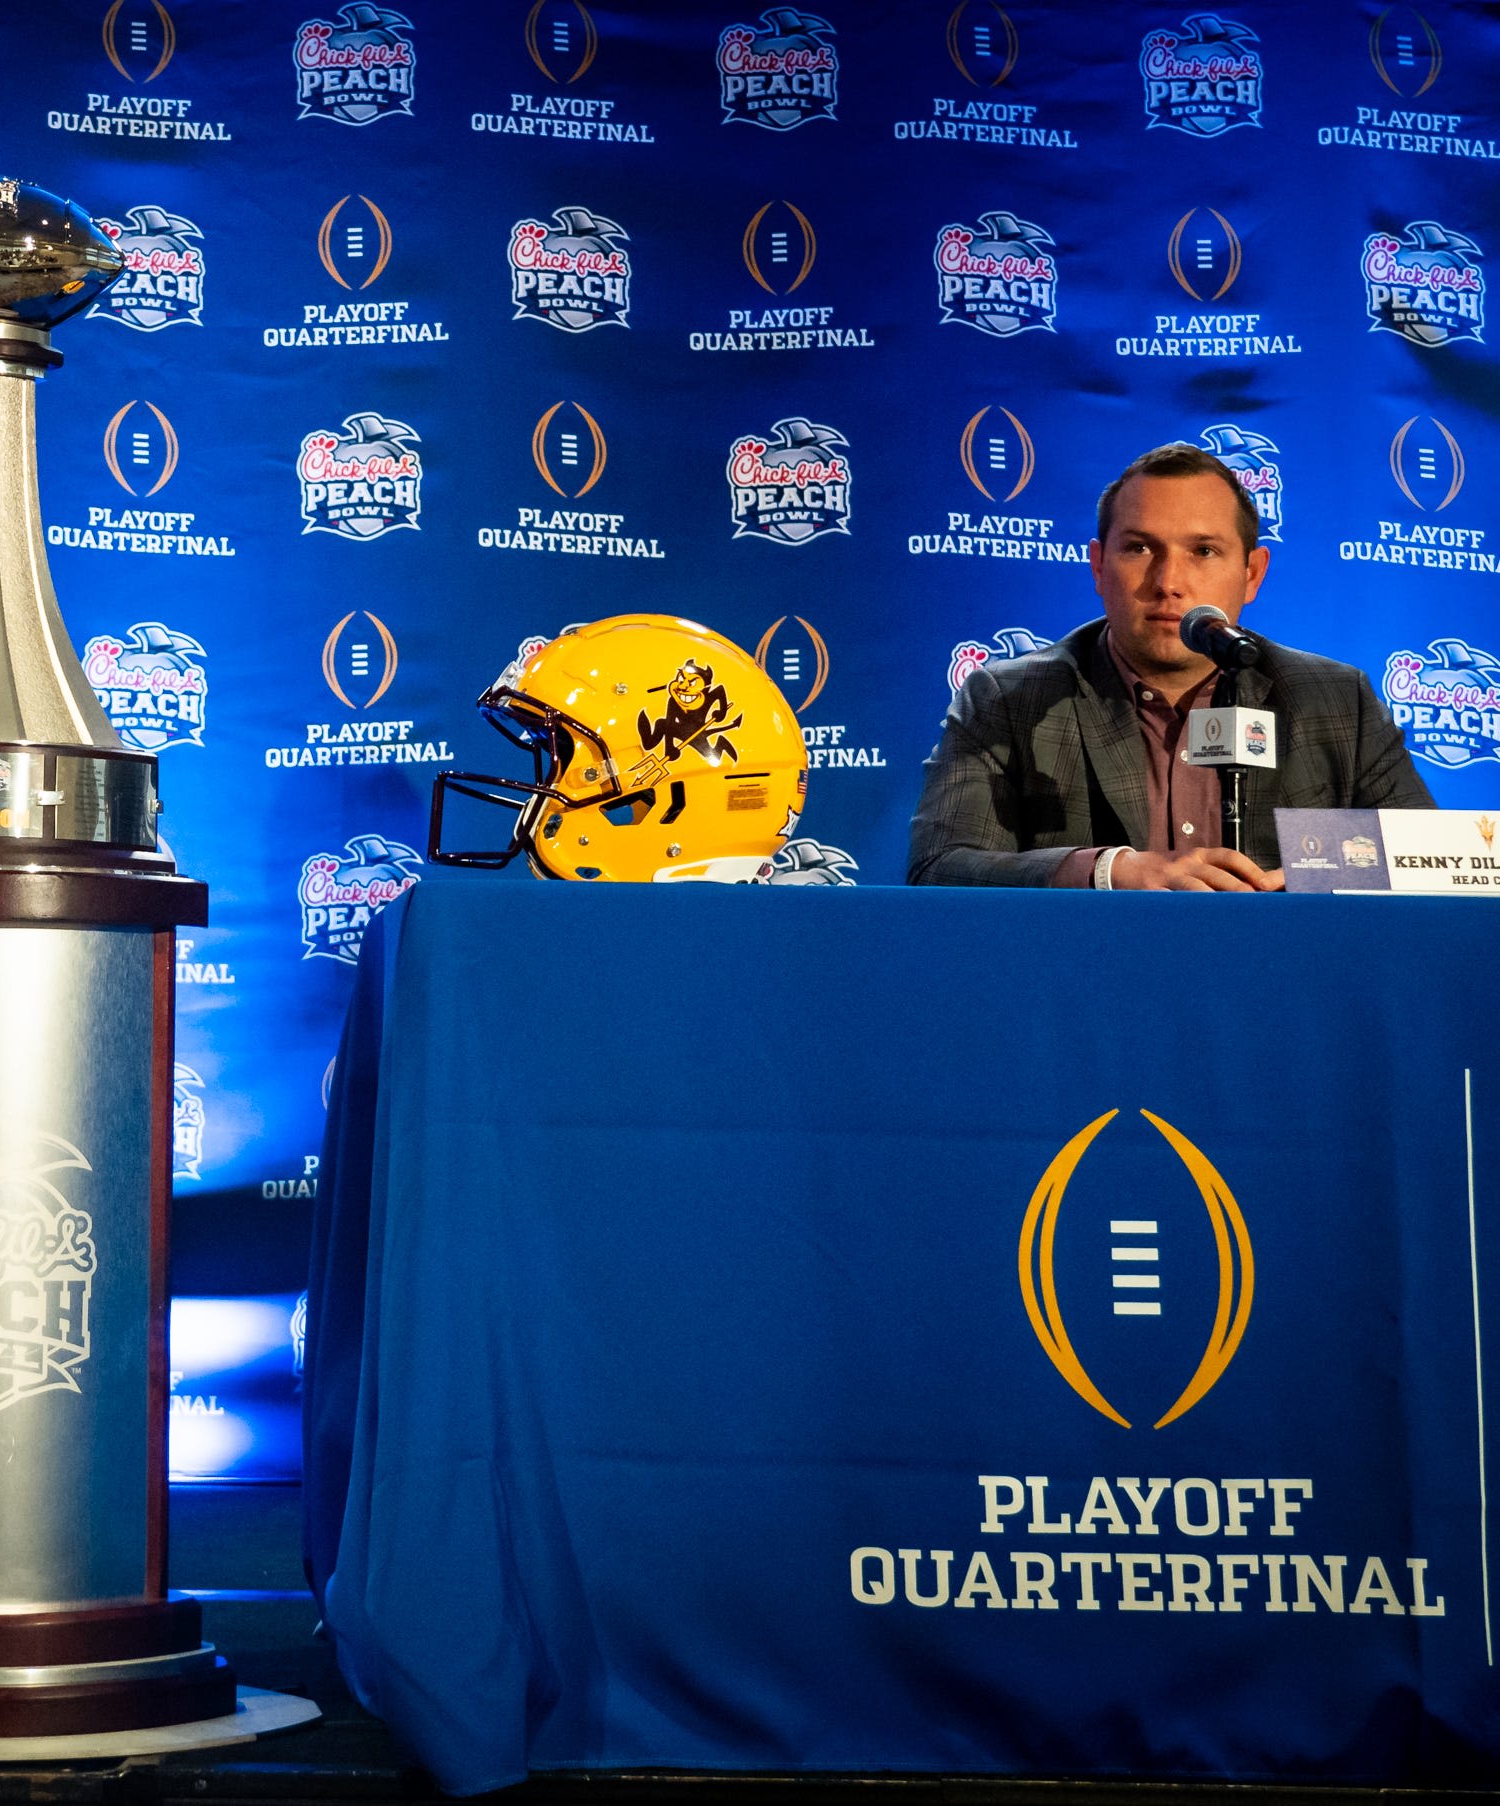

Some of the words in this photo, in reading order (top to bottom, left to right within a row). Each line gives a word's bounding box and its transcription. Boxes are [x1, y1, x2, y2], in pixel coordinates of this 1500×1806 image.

[299, 36, 409, 69] Chick-fil-A
[723, 41, 832, 73] Chick-fil-A
[1146, 46, 1256, 80] Chick-fil-A
[301, 68, 409, 98] PEACH
[725, 73, 832, 103] PEACH
[1149, 80, 1256, 108] PEACH
[88, 94, 191, 118] PLAYOFF
[323, 94, 388, 105] BOWL
[511, 94, 614, 119] PLAYOFF
[747, 99, 812, 110] BOWL
[934, 99, 1037, 124] PLAYOFF
[1171, 105, 1237, 116] BOWL
[48, 112, 231, 143] QUARTERFINAL
[471, 113, 654, 144] QUARTERFINAL
[894, 118, 1078, 149] QUARTERFINAL
[1357, 107, 1461, 134] PLAYOFF
[1318, 125, 1500, 159] QUARTERFINAL
[514, 236, 624, 275] Chick-fil-A
[940, 240, 1050, 280] Chick-fil-A
[1367, 249, 1478, 290] Chick-fil-A
[111, 272, 198, 304] EACH
[516, 271, 624, 306] PEACH
[943, 275, 1051, 311] PEACH
[112, 297, 177, 311] BOWL
[304, 302, 408, 323] PLAYOFF
[538, 299, 604, 312] BOWL
[965, 304, 1031, 317] BOWL
[1370, 284, 1479, 321] PEACH
[729, 308, 833, 328] PLAYOFF
[1156, 315, 1260, 334] PLAYOFF
[1393, 313, 1459, 327] BOWL
[264, 323, 449, 346] QUARTERFINAL
[690, 329, 875, 351] QUARTERFINAL
[1116, 337, 1302, 355] QUARTERFINAL
[304, 447, 415, 481] Chick-fil-A
[733, 452, 844, 486] Chick-fil-A
[306, 480, 415, 511] PEACH
[736, 485, 845, 516] PEACH
[89, 508, 194, 532] PLAYOFF
[328, 507, 394, 519] BOWL
[519, 509, 624, 533] PLAYOFF
[758, 512, 825, 523] BOWL
[948, 513, 1053, 538] PLAYOFF
[49, 527, 235, 558] QUARTERFINAL
[479, 528, 665, 559] QUARTERFINAL
[909, 533, 1091, 563] QUARTERFINAL
[1379, 522, 1484, 549] PLAYOFF
[1340, 541, 1500, 573] QUARTERFIN
[89, 654, 199, 693] Chick-fil-A
[111, 717, 178, 731] BOWL
[307, 721, 413, 743] PLAYOFF
[1414, 733, 1481, 748] BOWL
[266, 743, 454, 767] QUARTERFINAL
[1393, 856, 1463, 869] KENNY
[1452, 875, 1489, 885] HEAD
[307, 907, 385, 937] PEA
[978, 1475, 1313, 1536] PLAYOFF
[850, 1546, 1446, 1616] QUARTERFINAL
